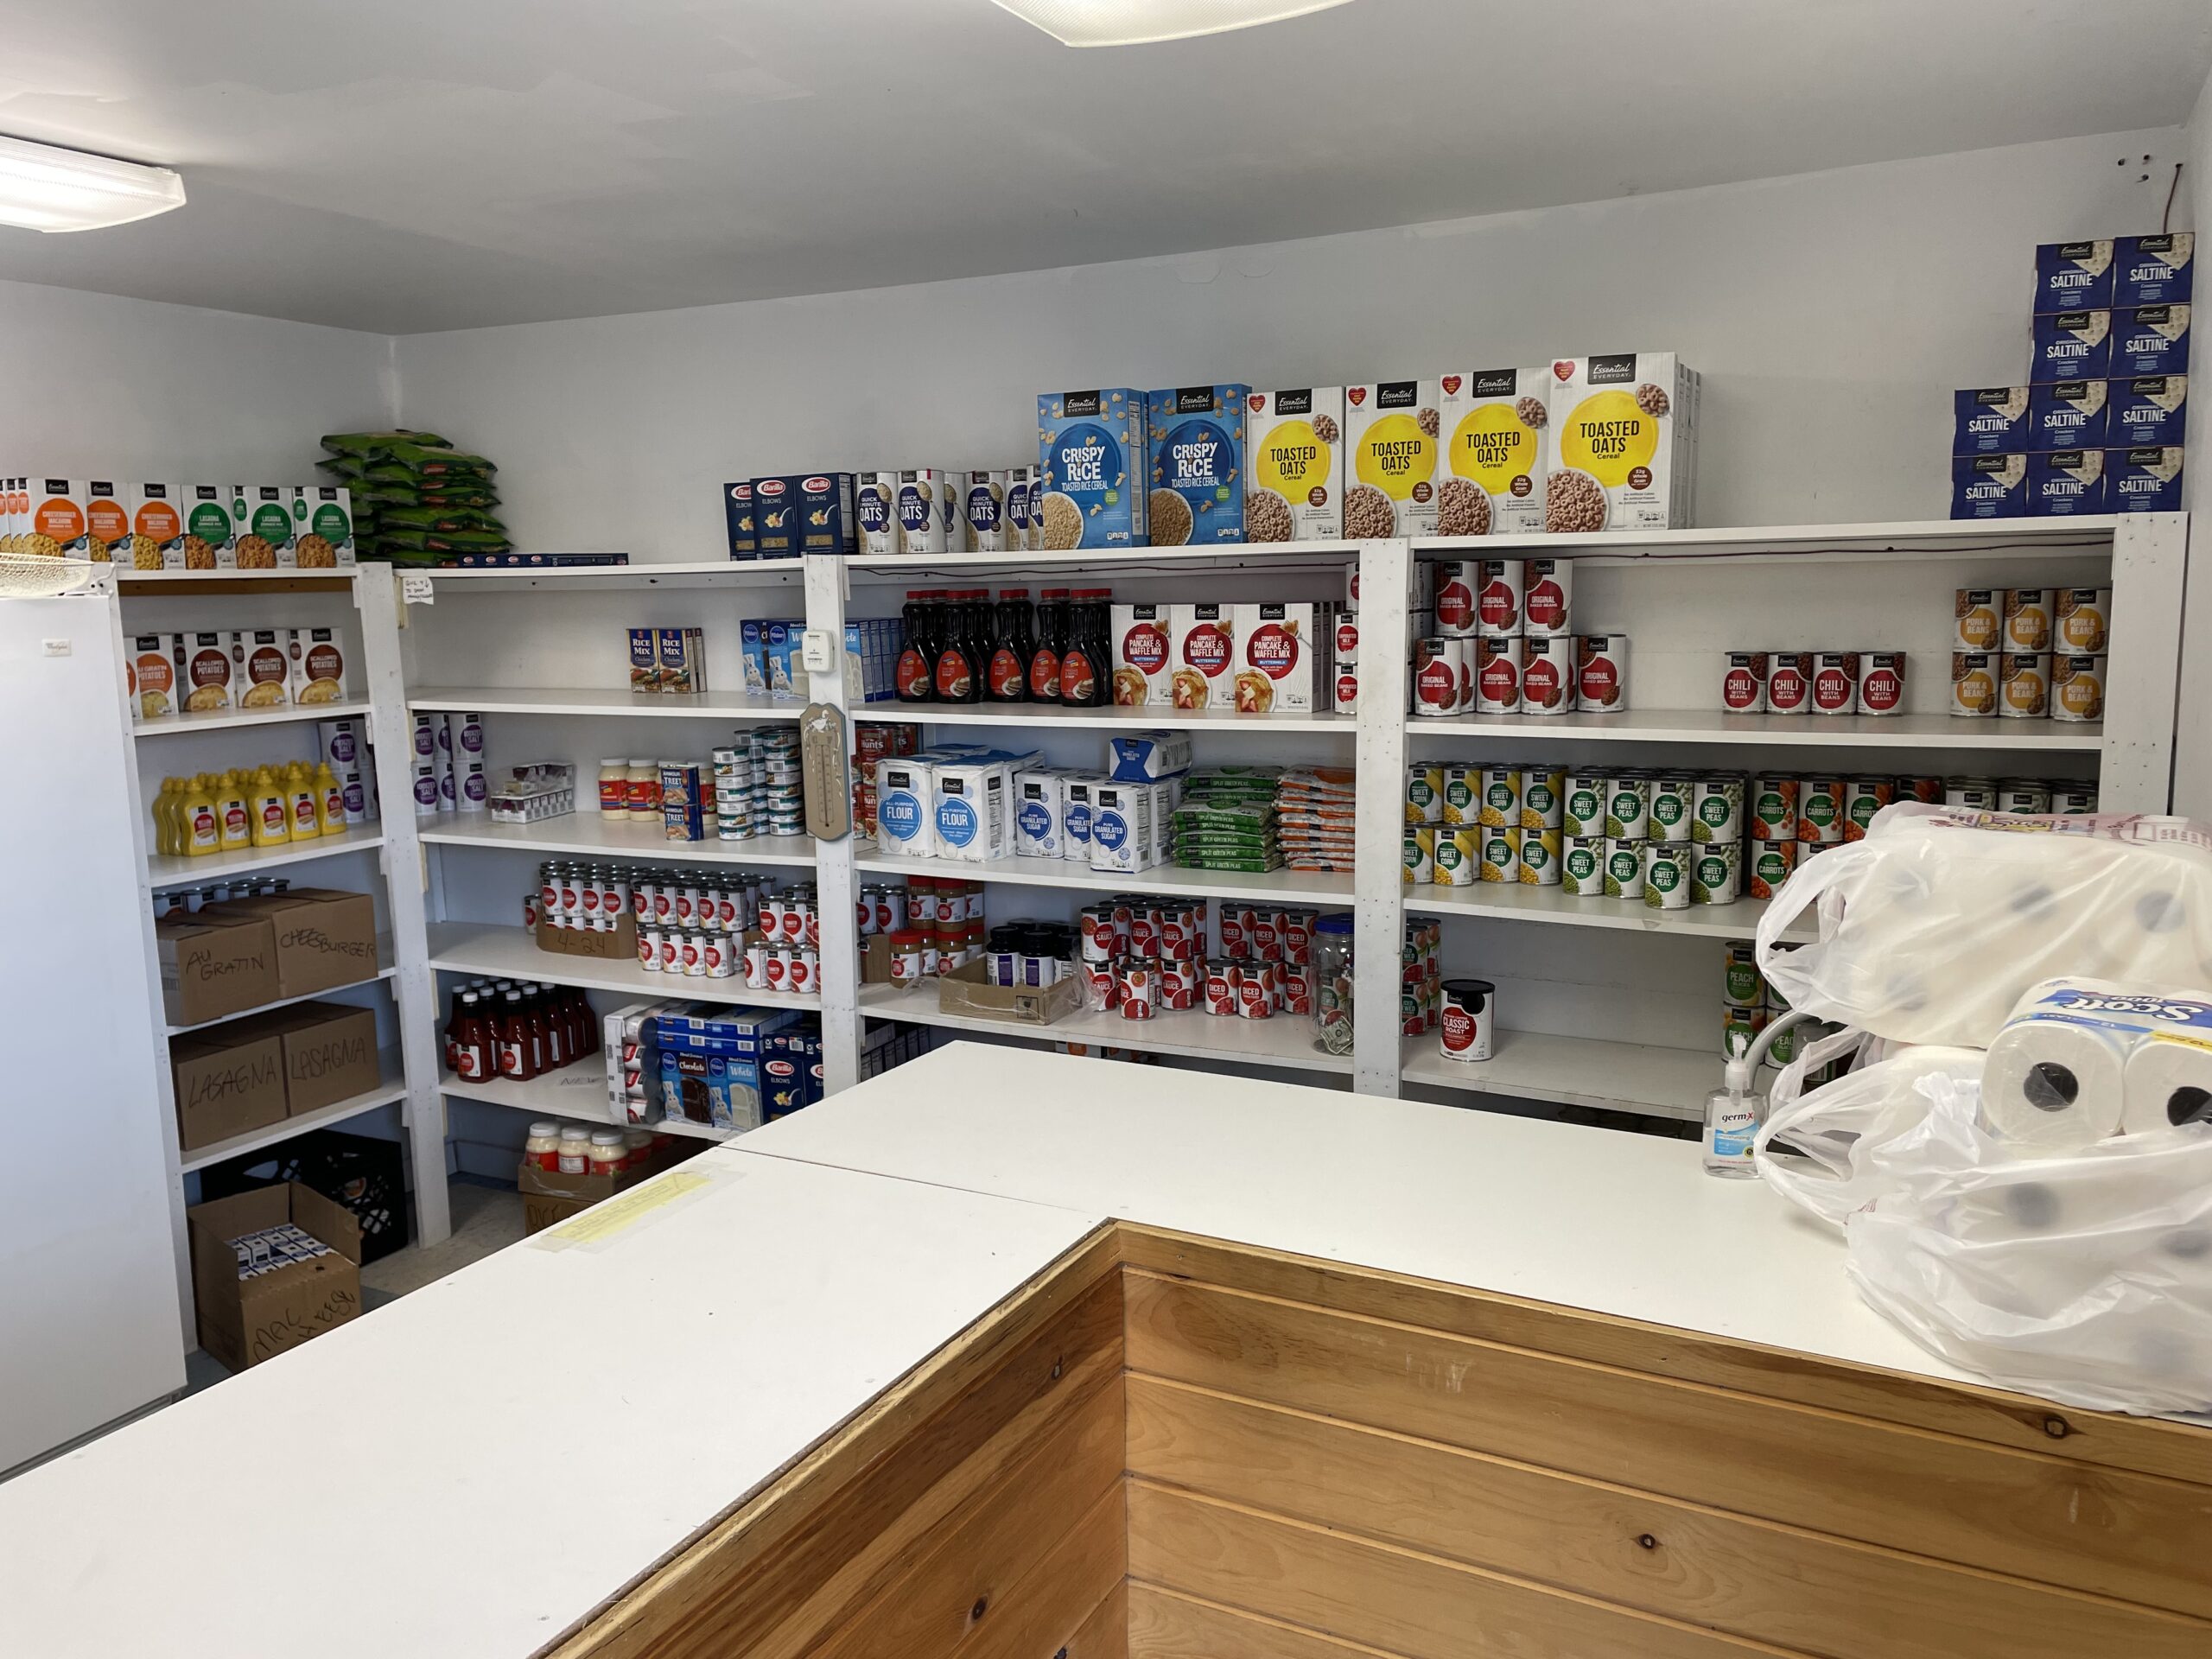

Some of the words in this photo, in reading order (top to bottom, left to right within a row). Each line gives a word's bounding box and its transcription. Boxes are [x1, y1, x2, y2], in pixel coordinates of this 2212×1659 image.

[2130, 267, 2173, 282] SALTINE
[2050, 274, 2093, 289] SALTINE
[2047, 344, 2088, 359] SALTINE
[2126, 339, 2169, 353] SALTINE
[1592, 364, 1630, 376] Essential
[1478, 378, 1511, 390] Essential
[1068, 399, 1096, 410] Essential
[1180, 395, 1210, 405] Essential
[1279, 397, 1306, 408] Essential
[2044, 414, 2086, 428] SALTINE
[2123, 410, 2166, 423] SALTINE
[1580, 420, 1640, 438] TOASTED
[1968, 419, 2009, 432] SALTINE
[1466, 432, 1520, 448] TOASTED
[1592, 437, 1625, 454] OATS
[1062, 446, 1105, 463] CRISPY
[1173, 442, 1217, 459] CRISPY
[1270, 446, 1316, 461] TOASTED
[1371, 441, 1421, 456] TOASTED
[1478, 448, 1508, 462] OATS
[1179, 459, 1213, 478] RICE
[1280, 461, 1306, 474] OATS
[1382, 456, 1410, 470] OATS
[1067, 462, 1102, 481] RICE
[807, 480, 829, 488] Barilla
[1061, 481, 1081, 493] TOASTED
[1081, 481, 1090, 491] RICE
[1091, 480, 1108, 491] CEREAL
[1172, 478, 1192, 487] TOASTED
[1192, 477, 1202, 486] RICE
[1203, 476, 1220, 486] CEREAL
[2119, 480, 2162, 493] SALTINE
[1966, 486, 2006, 499] SALTINE
[2043, 482, 2084, 496] SALTINE
[860, 506, 882, 521] OATS
[900, 505, 922, 519] OATS
[970, 506, 994, 521] OATS
[1129, 639, 1154, 648] PANCAKE
[1255, 641, 1281, 650] PANCAKE
[1152, 647, 1161, 656] MIX
[1255, 649, 1277, 658] WAFFLE
[1279, 650, 1290, 658] MIX
[1728, 680, 1750, 690] CHILI
[1775, 680, 1798, 690] CHILI
[1820, 680, 1843, 690] CHILI
[1870, 681, 1894, 691] CHILI
[887, 807, 912, 820] FLOUR
[942, 813, 968, 826] FLOUR
[186, 950, 211, 975] AU
[201, 956, 264, 981] GRATIN
[1730, 973, 1753, 982] PEACH
[2063, 998, 2203, 1021] Scott
[1443, 1016, 1469, 1029] CLASSIC
[290, 1038, 365, 1080] LASAGNA
[188, 1055, 277, 1108] LASAGNA
